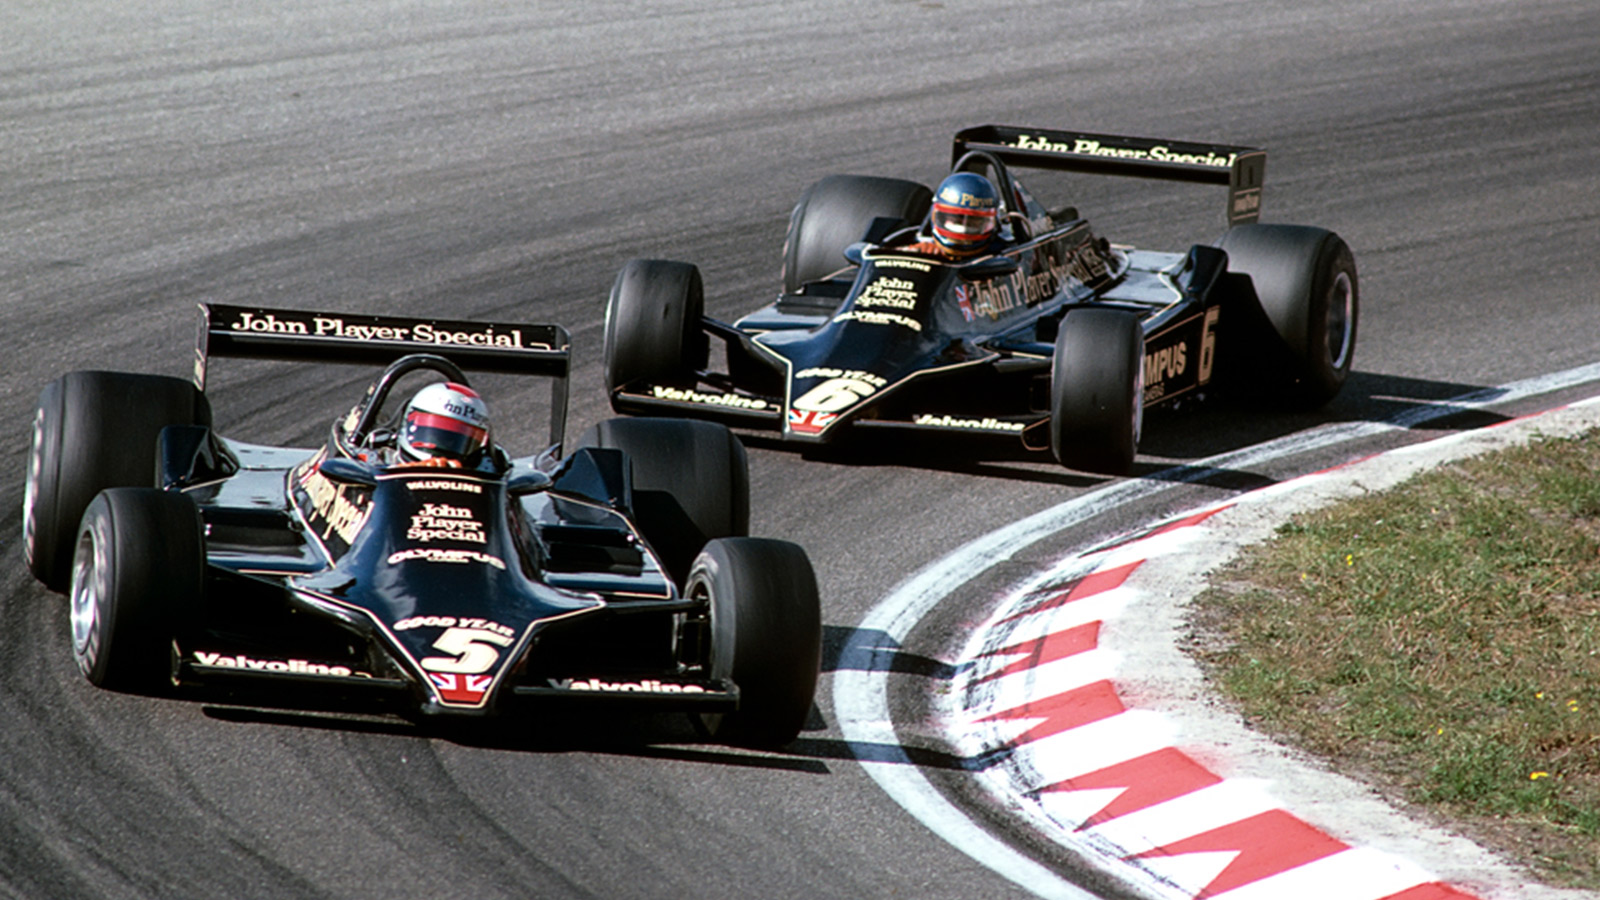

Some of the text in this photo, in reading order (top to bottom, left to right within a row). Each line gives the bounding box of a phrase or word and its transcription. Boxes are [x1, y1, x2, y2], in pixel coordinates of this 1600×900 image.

[1008, 135, 1068, 152] John
[1148, 146, 1237, 168] Special
[865, 286, 918, 300] Player
[872, 277, 914, 290] John
[854, 295, 916, 310] Special
[231, 312, 523, 349] John Player Special
[1198, 305, 1221, 386] 6
[653, 386, 767, 409] Valvoline
[793, 378, 876, 412] 6
[406, 481, 482, 494] VALVOLINE
[418, 503, 473, 519] John
[410, 516, 483, 531] Player
[406, 527, 487, 543] Special
[387, 549, 506, 570] OLYMPUS
[393, 616, 515, 637] GOOD YEAR
[420, 627, 515, 674] 5
[193, 651, 351, 677] Valvoline
